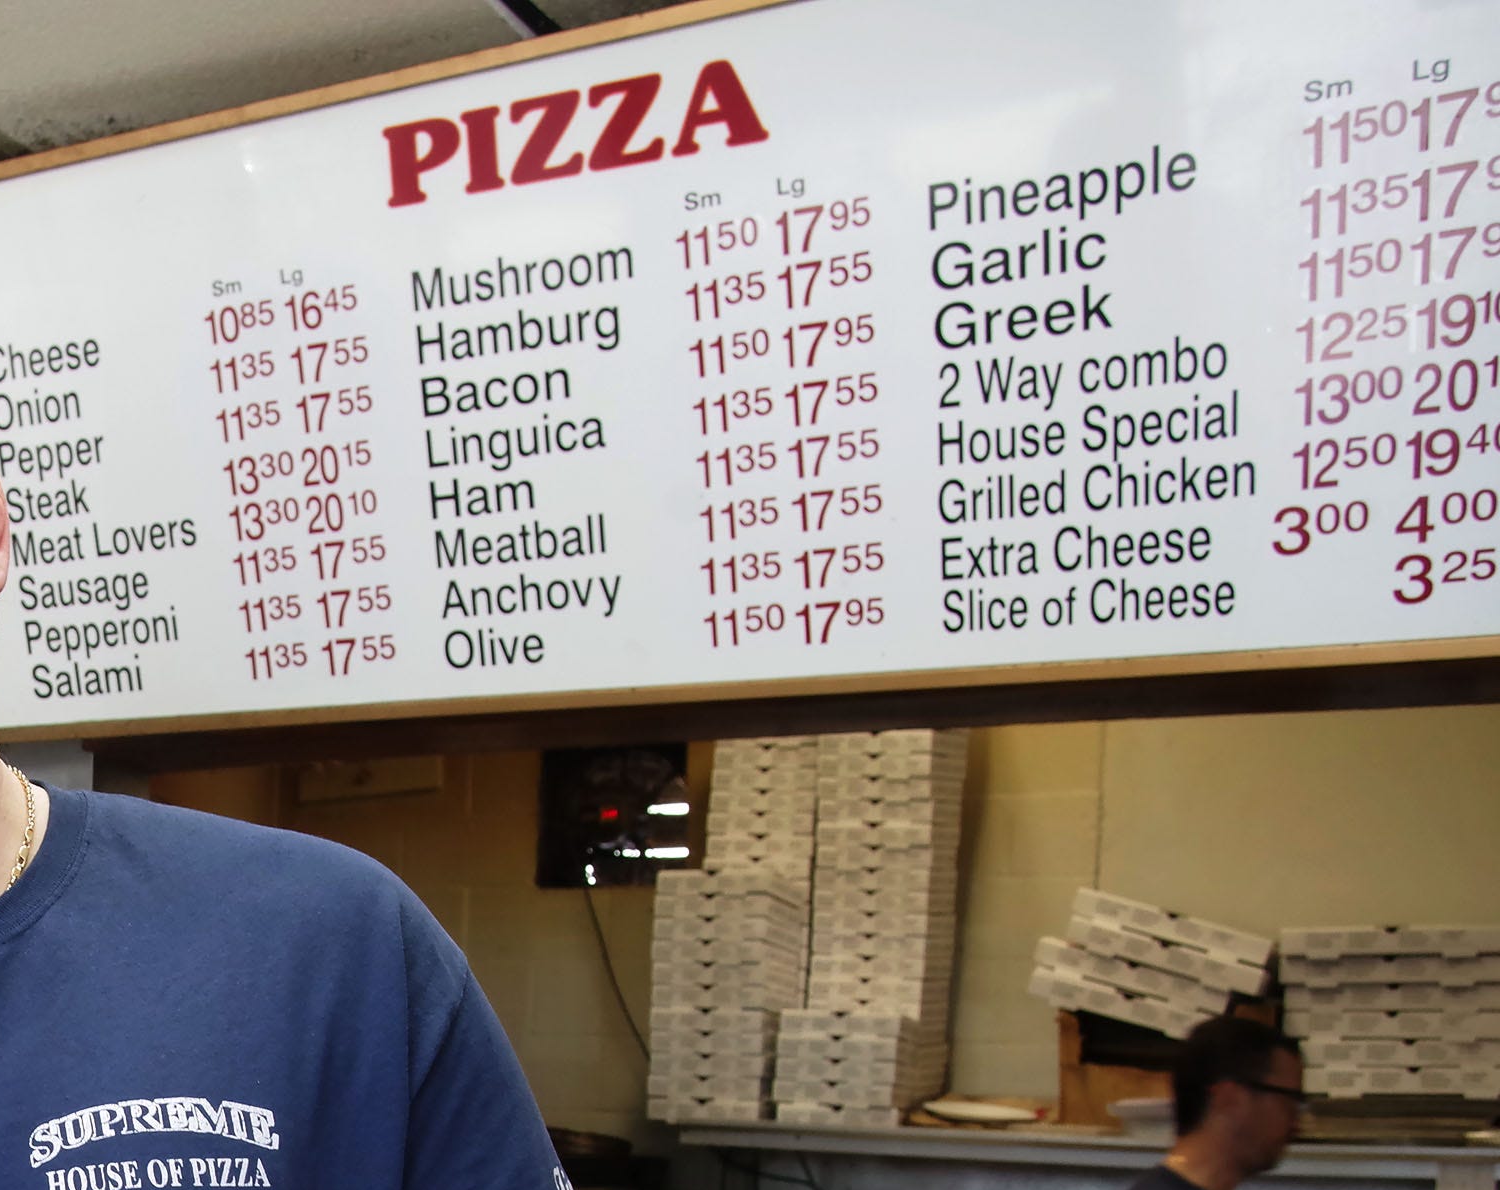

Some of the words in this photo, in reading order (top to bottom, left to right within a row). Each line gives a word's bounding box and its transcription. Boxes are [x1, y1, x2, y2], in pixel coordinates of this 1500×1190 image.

[1304, 80, 1352, 102] Sm
[1413, 59, 1450, 83] Lg
[382, 59, 770, 208] PIZZA
[685, 192, 721, 211] Sm
[777, 178, 805, 198] Lg
[928, 144, 1197, 230] Pineapple
[212, 280, 242, 297] Sm
[280, 270, 303, 286] Lg
[411, 246, 634, 312] Mushroom
[931, 225, 1107, 291] Garlic
[416, 306, 620, 365] Hamburg
[934, 283, 1113, 350] Greek
[420, 368, 571, 420] Bacon
[975, 356, 1063, 412] Way
[1079, 335, 1228, 394] combo
[425, 413, 606, 472] Linguica
[938, 420, 1066, 466] House
[1082, 389, 1239, 462] Special
[5, 479, 90, 524] Steak
[429, 478, 535, 520] Ham
[938, 468, 1066, 525] Grilled
[1083, 456, 1256, 512] Chicken
[11, 526, 85, 568] Meat
[93, 518, 197, 558] Lovers
[435, 513, 606, 569] Meatball
[940, 536, 1039, 581] Extra
[1053, 525, 1212, 573] Cheese
[19, 572, 148, 611] Sausage
[442, 573, 621, 619] Anchovy
[943, 588, 1028, 634] Slice
[1042, 586, 1077, 627] of
[1090, 577, 1236, 624] Cheese
[24, 604, 179, 661] Pepperoni
[444, 628, 544, 670] Olive
[32, 652, 144, 699] Salami
[29, 1096, 280, 1168] SUPREME
[147, 1158, 185, 1188] OF
[189, 1158, 272, 1187] PIZZA
